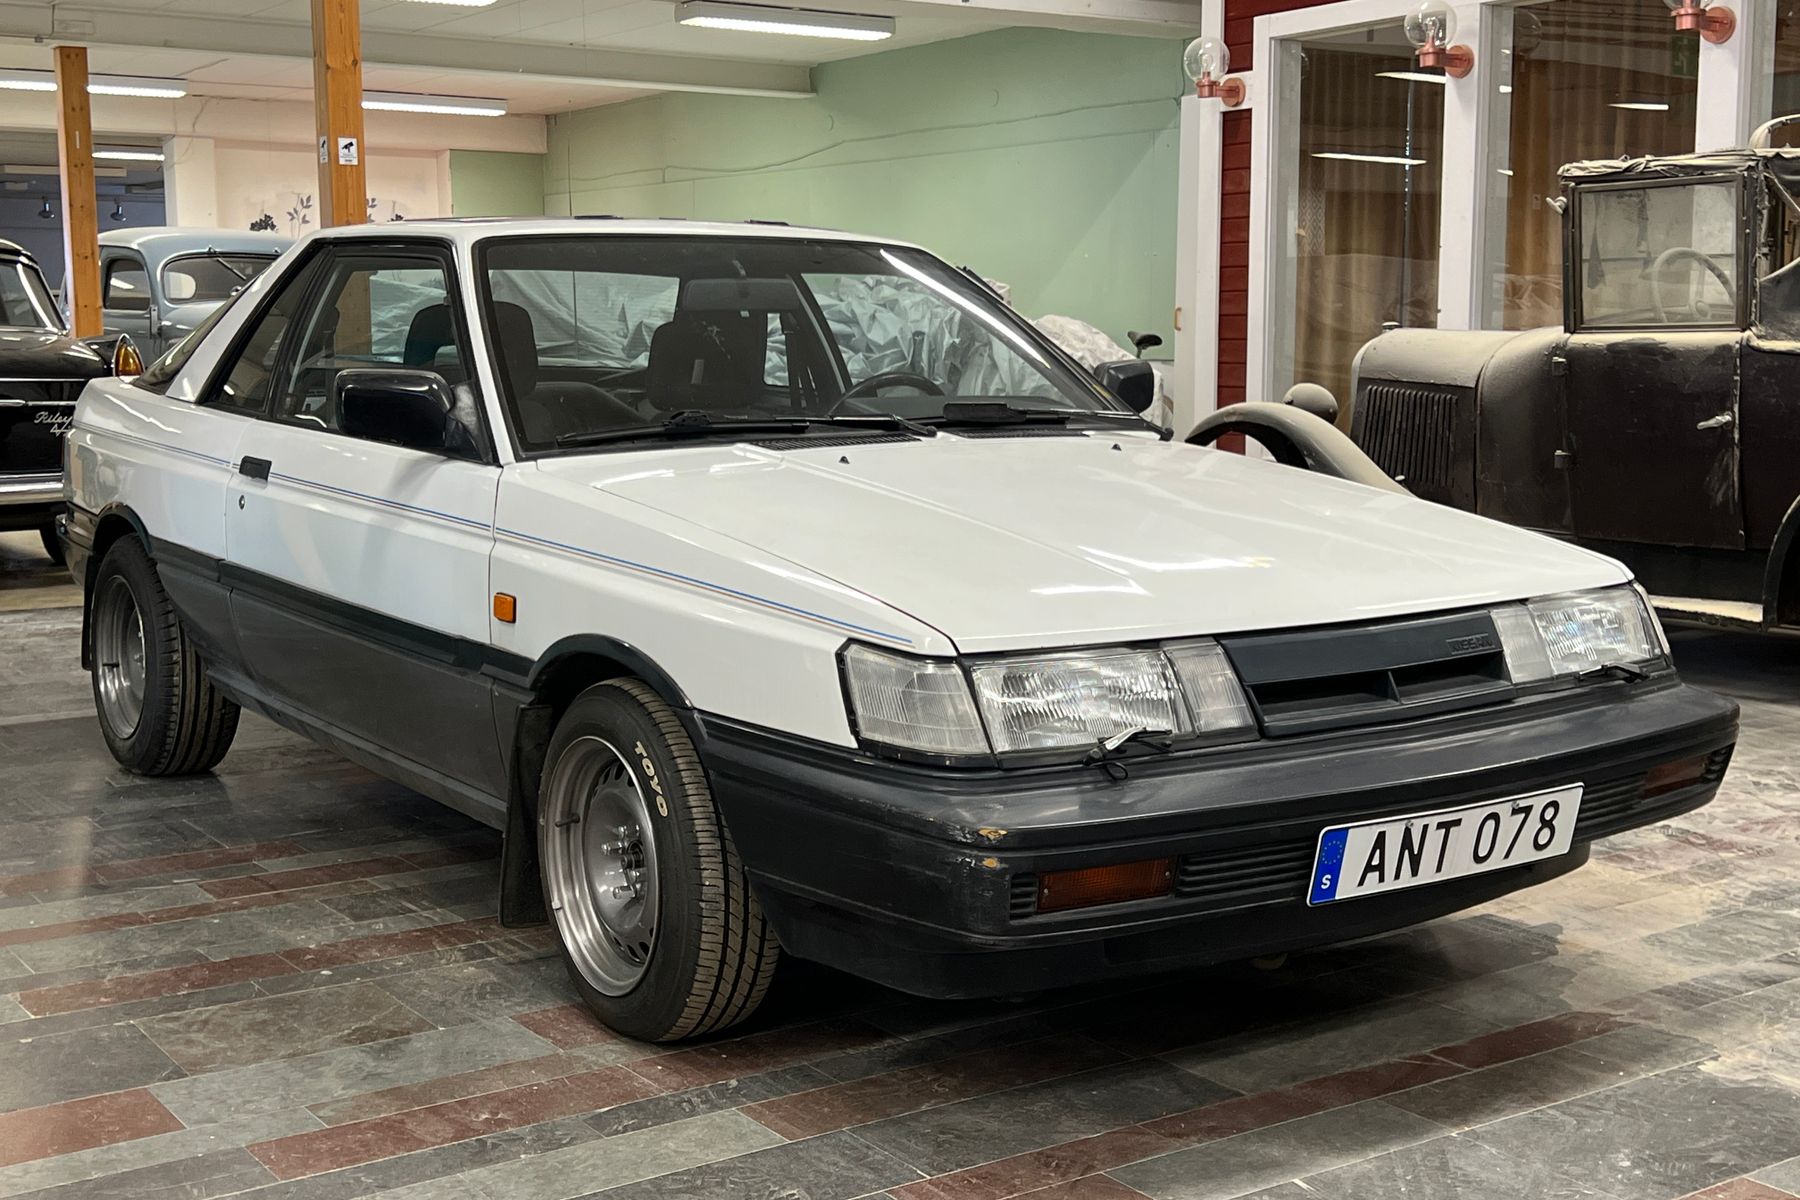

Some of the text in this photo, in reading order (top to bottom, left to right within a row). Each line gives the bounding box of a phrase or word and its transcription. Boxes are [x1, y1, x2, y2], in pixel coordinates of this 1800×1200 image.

[634, 740, 668, 817] TOYO
[1321, 874, 1332, 889] S
[1357, 800, 1560, 887] ANT 078
